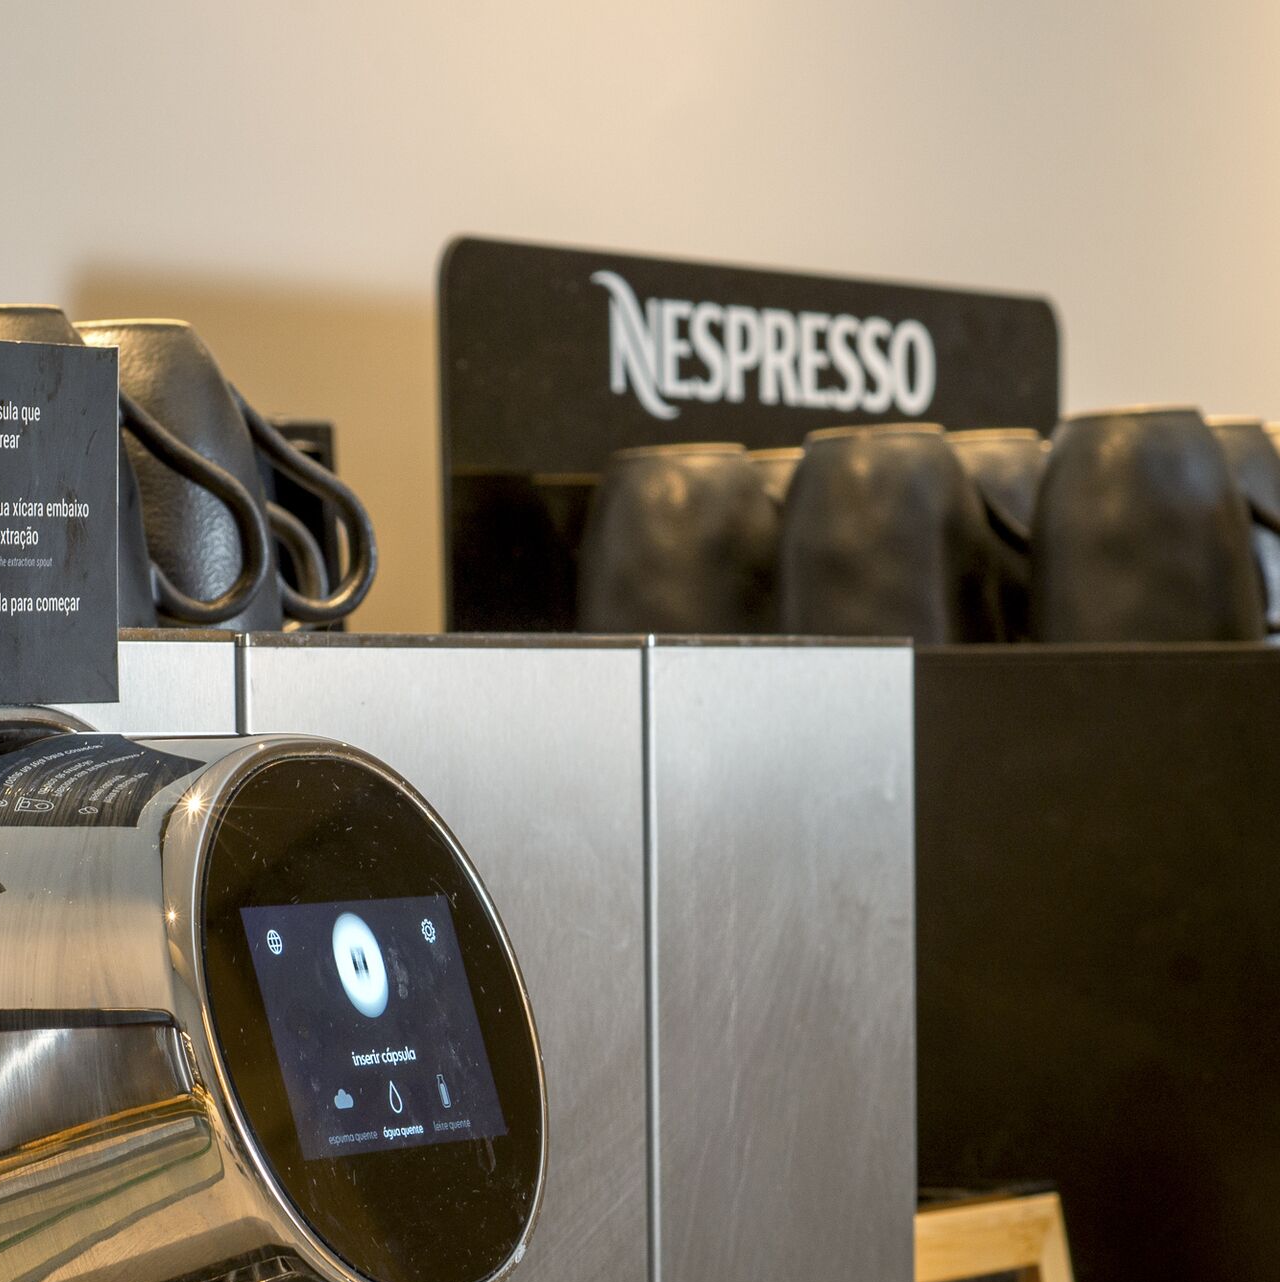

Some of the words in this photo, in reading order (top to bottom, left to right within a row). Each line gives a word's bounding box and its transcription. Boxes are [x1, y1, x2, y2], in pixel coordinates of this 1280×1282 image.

[590, 269, 937, 421] NESPRESSO
[21, 405, 41, 426] que
[12, 497, 44, 517] xícara
[46, 497, 90, 518] embaixo
[7, 556, 36, 568] extraction
[10, 597, 34, 617] para
[35, 596, 81, 617] começar
[351, 1049, 380, 1067] inserir
[381, 1045, 417, 1066] cápsula
[383, 1126, 400, 1140] água
[400, 1124, 424, 1138] quente
